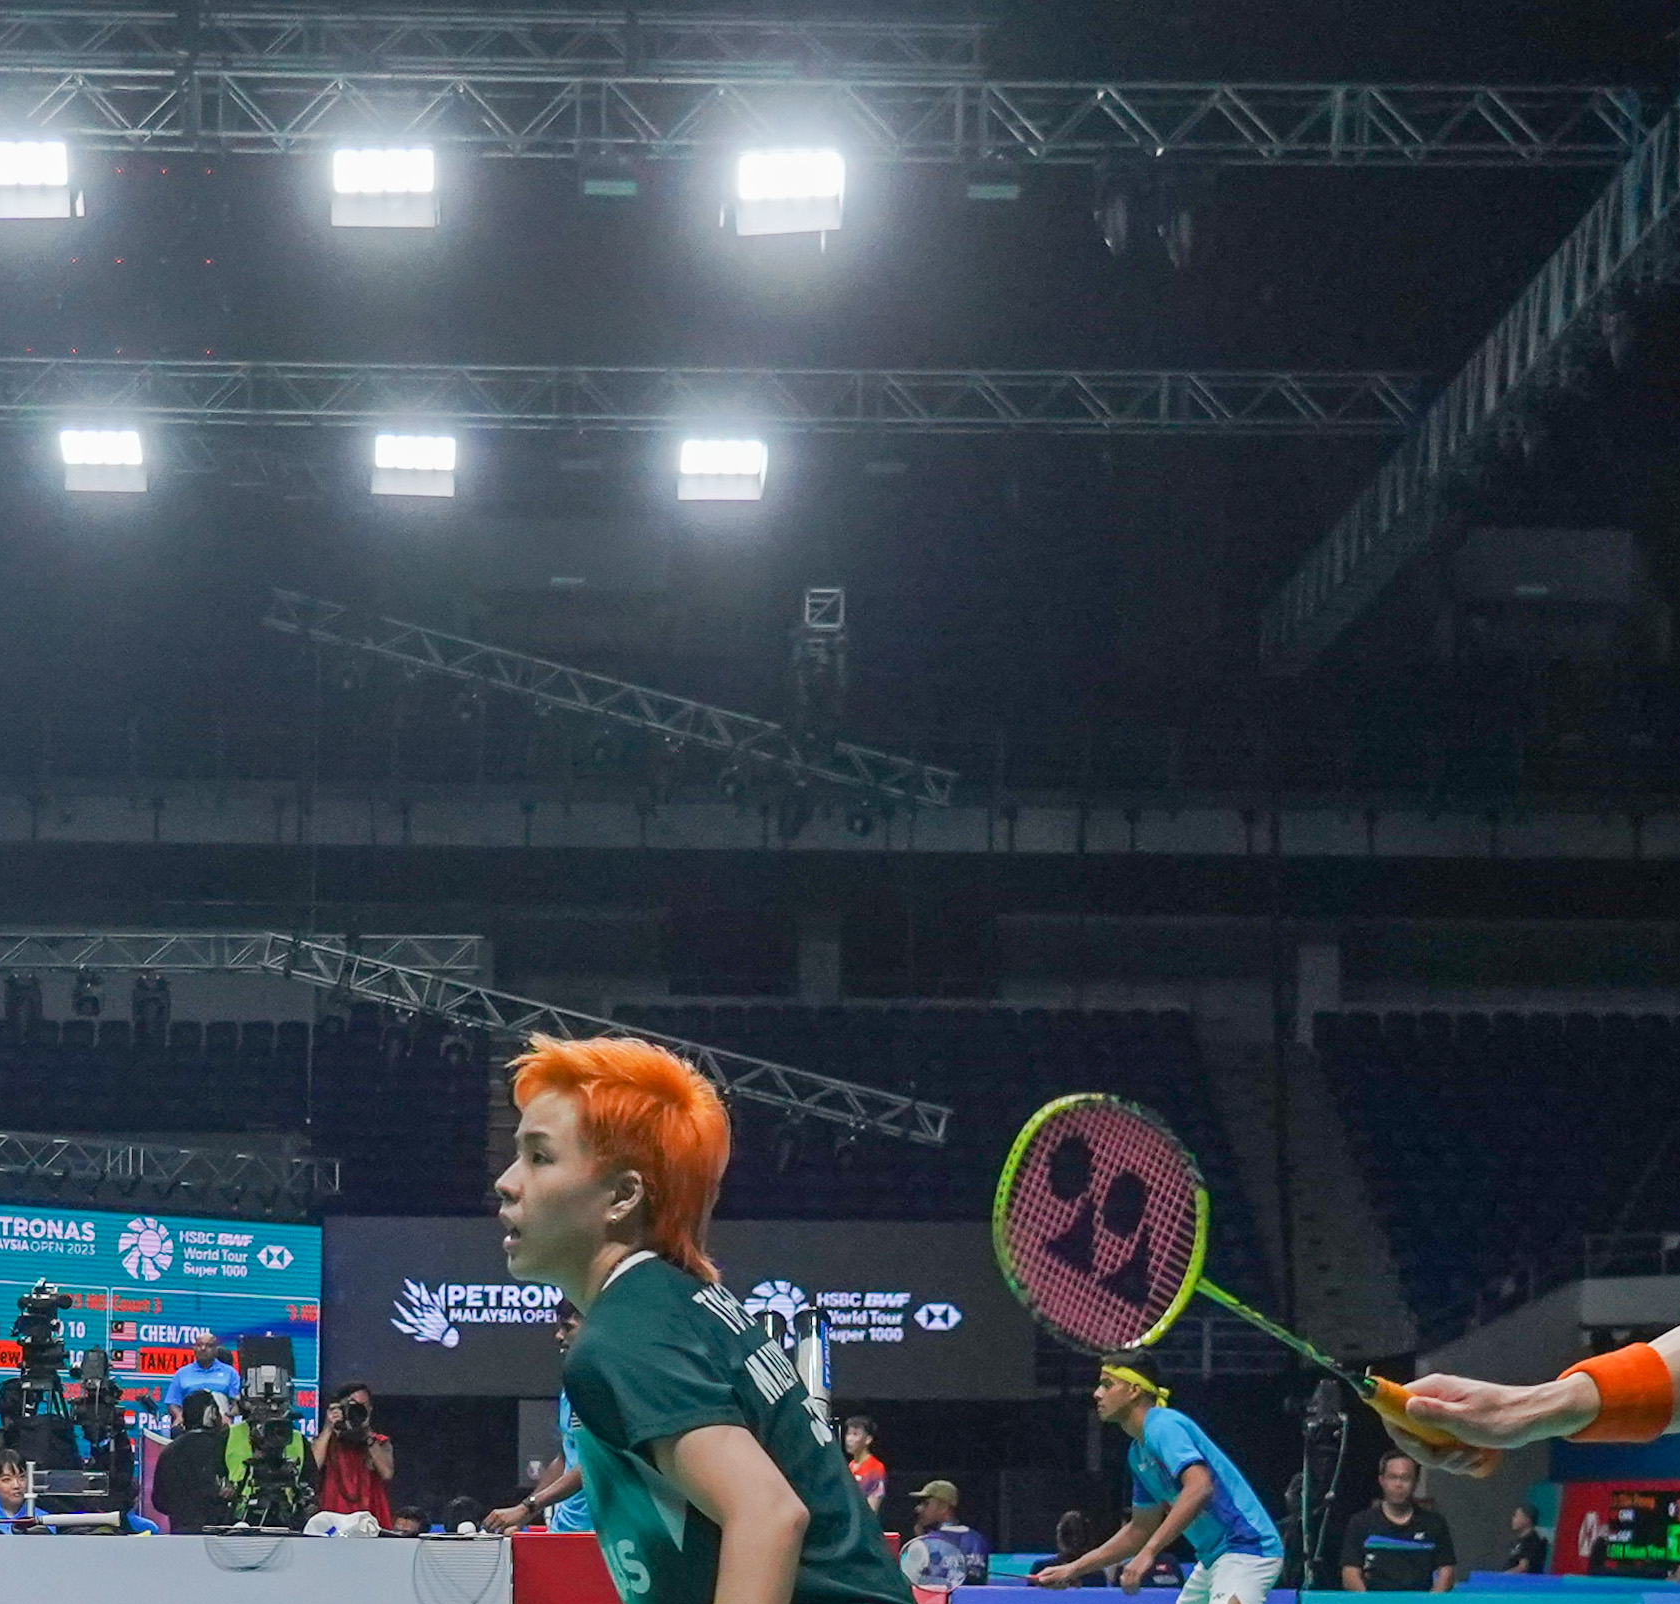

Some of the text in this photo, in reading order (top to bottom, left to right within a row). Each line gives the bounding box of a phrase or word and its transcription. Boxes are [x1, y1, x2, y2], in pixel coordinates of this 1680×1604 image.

[179, 1230, 254, 1247] HSBC BWF
[30, 1240, 64, 1254] OPEN
[67, 1243, 96, 1256] 2023
[183, 1247, 248, 1263] World Tour
[183, 1262, 248, 1277] Super 1000
[112, 1295, 150, 1314] Court
[816, 1292, 911, 1308] HSBC BWF
[449, 1308, 521, 1324] MALAYSIA
[869, 1309, 904, 1325] Tour
[140, 1324, 211, 1344] CHEN/TOH
[868, 1326, 904, 1342] 1000
[139, 1352, 194, 1371] TAN/LA
